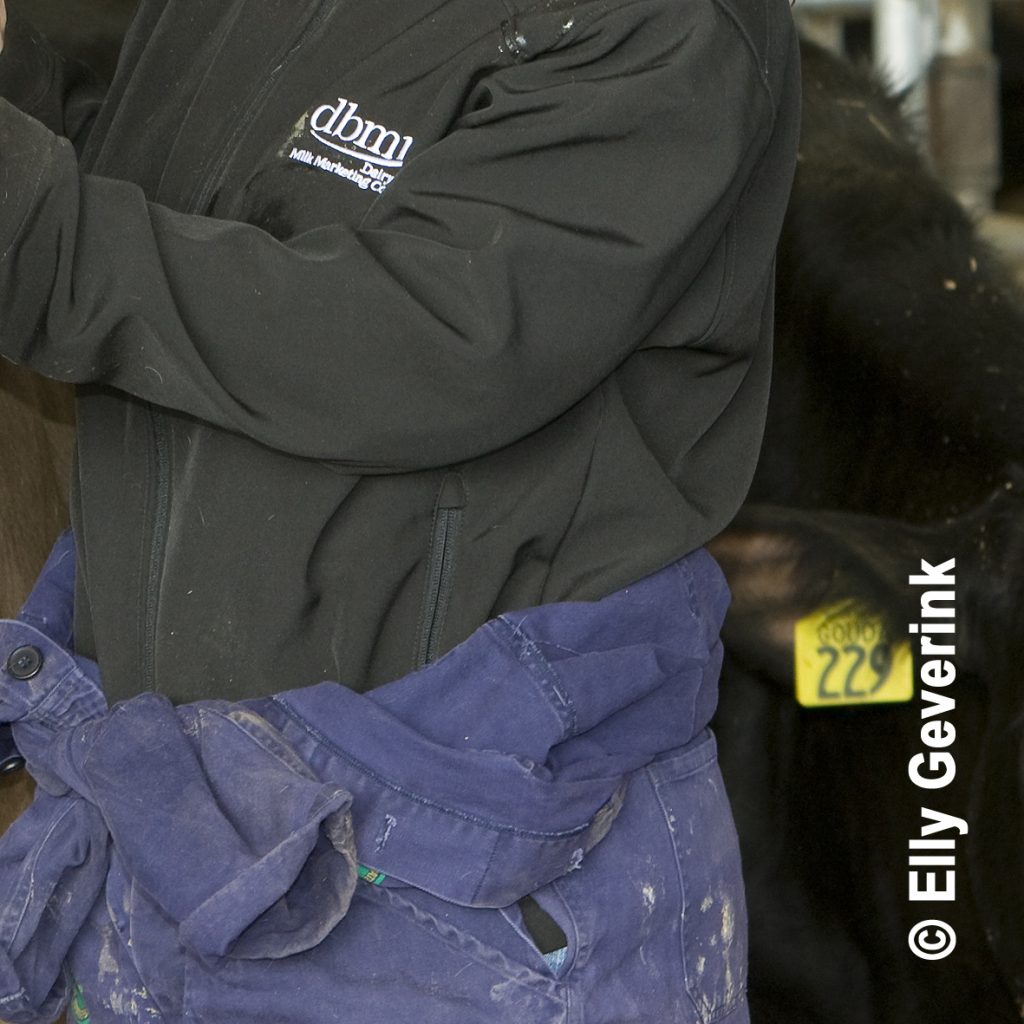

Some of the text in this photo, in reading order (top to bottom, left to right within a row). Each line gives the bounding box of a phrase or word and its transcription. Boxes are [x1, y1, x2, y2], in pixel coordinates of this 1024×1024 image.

[289, 147, 315, 165] Milk
[313, 154, 372, 190] Marketing
[359, 161, 395, 187] Dairy
[817, 643, 893, 699] 229
